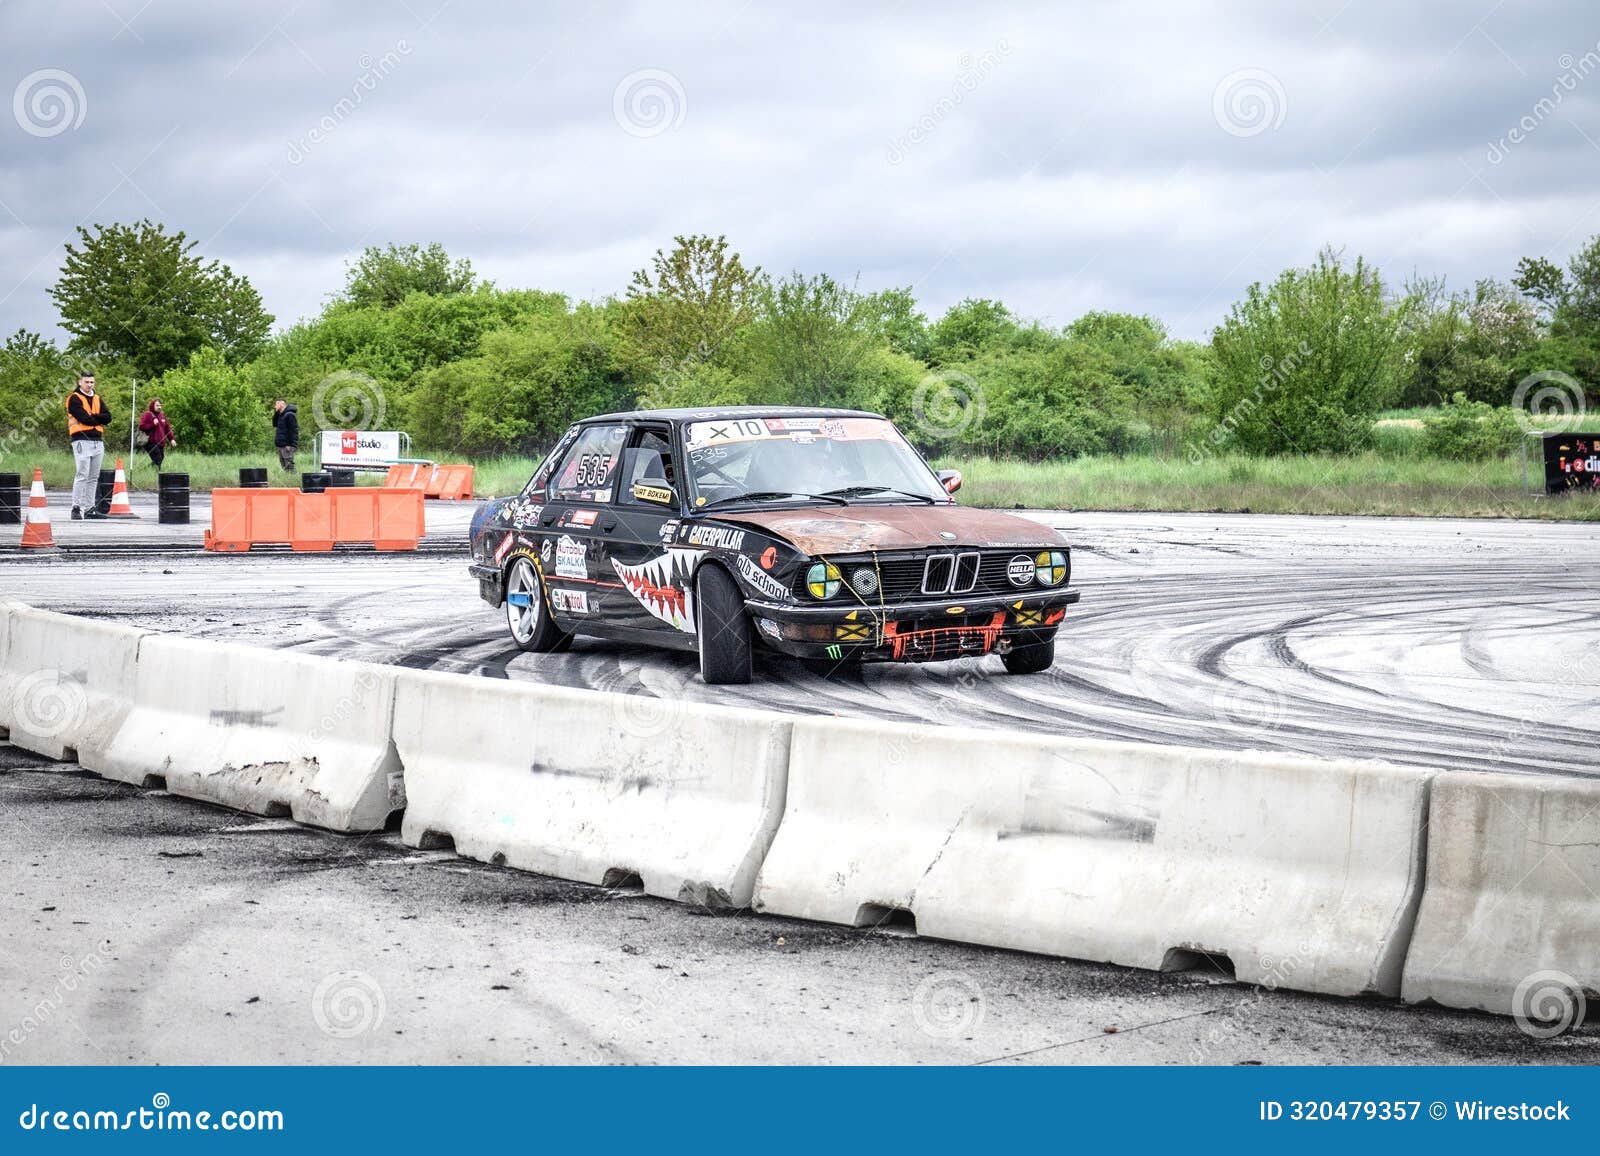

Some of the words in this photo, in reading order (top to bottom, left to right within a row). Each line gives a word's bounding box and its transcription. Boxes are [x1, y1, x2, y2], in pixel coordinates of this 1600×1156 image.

[691, 447, 728, 465] 535
[576, 453, 611, 486] 535
[688, 525, 745, 551] CATERPILLAR
[557, 555, 585, 568] SKALKA
[1010, 565, 1034, 575] HELLA
[752, 570, 787, 601] school
[560, 591, 584, 610] Cstrol
